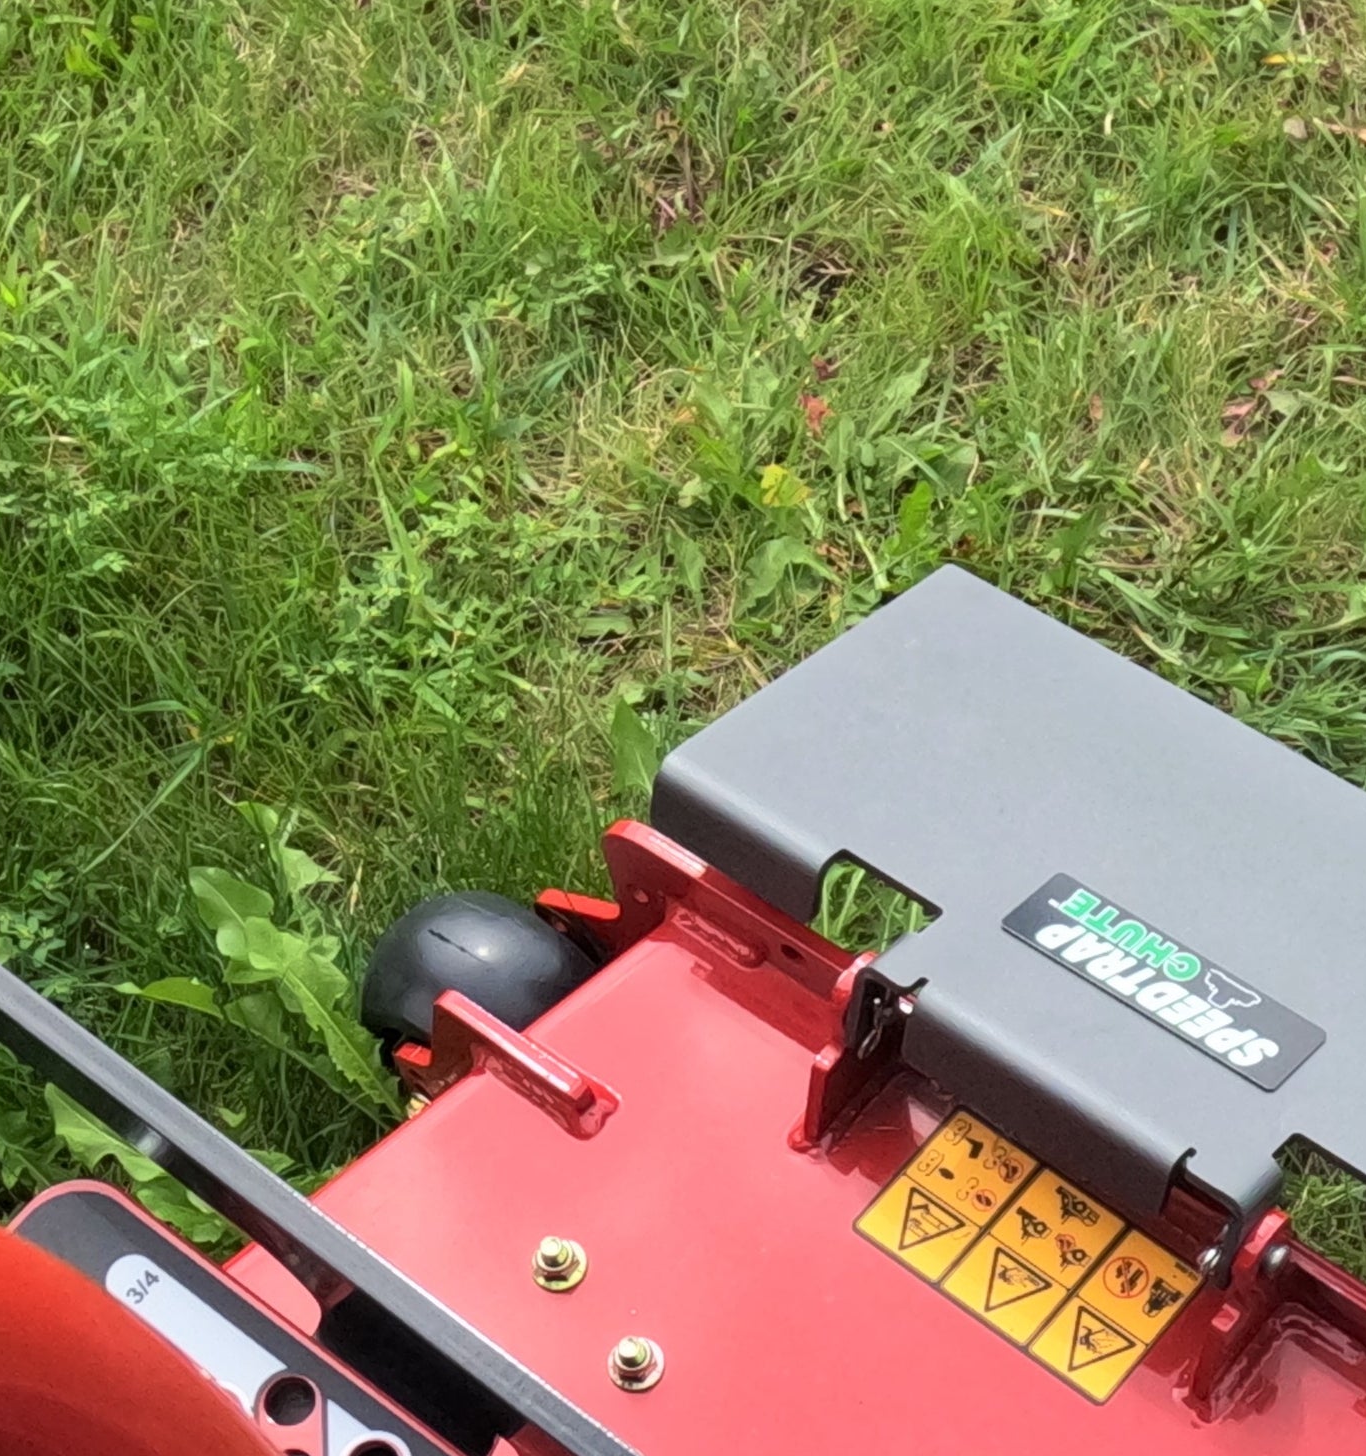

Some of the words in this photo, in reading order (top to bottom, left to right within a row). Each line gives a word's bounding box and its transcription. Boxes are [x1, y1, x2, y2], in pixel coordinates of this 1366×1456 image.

[1059, 888, 1201, 982] CHUTE
[1035, 924, 1280, 1066] SPEEDTRAP
[125, 1269, 161, 1305] 3/4
